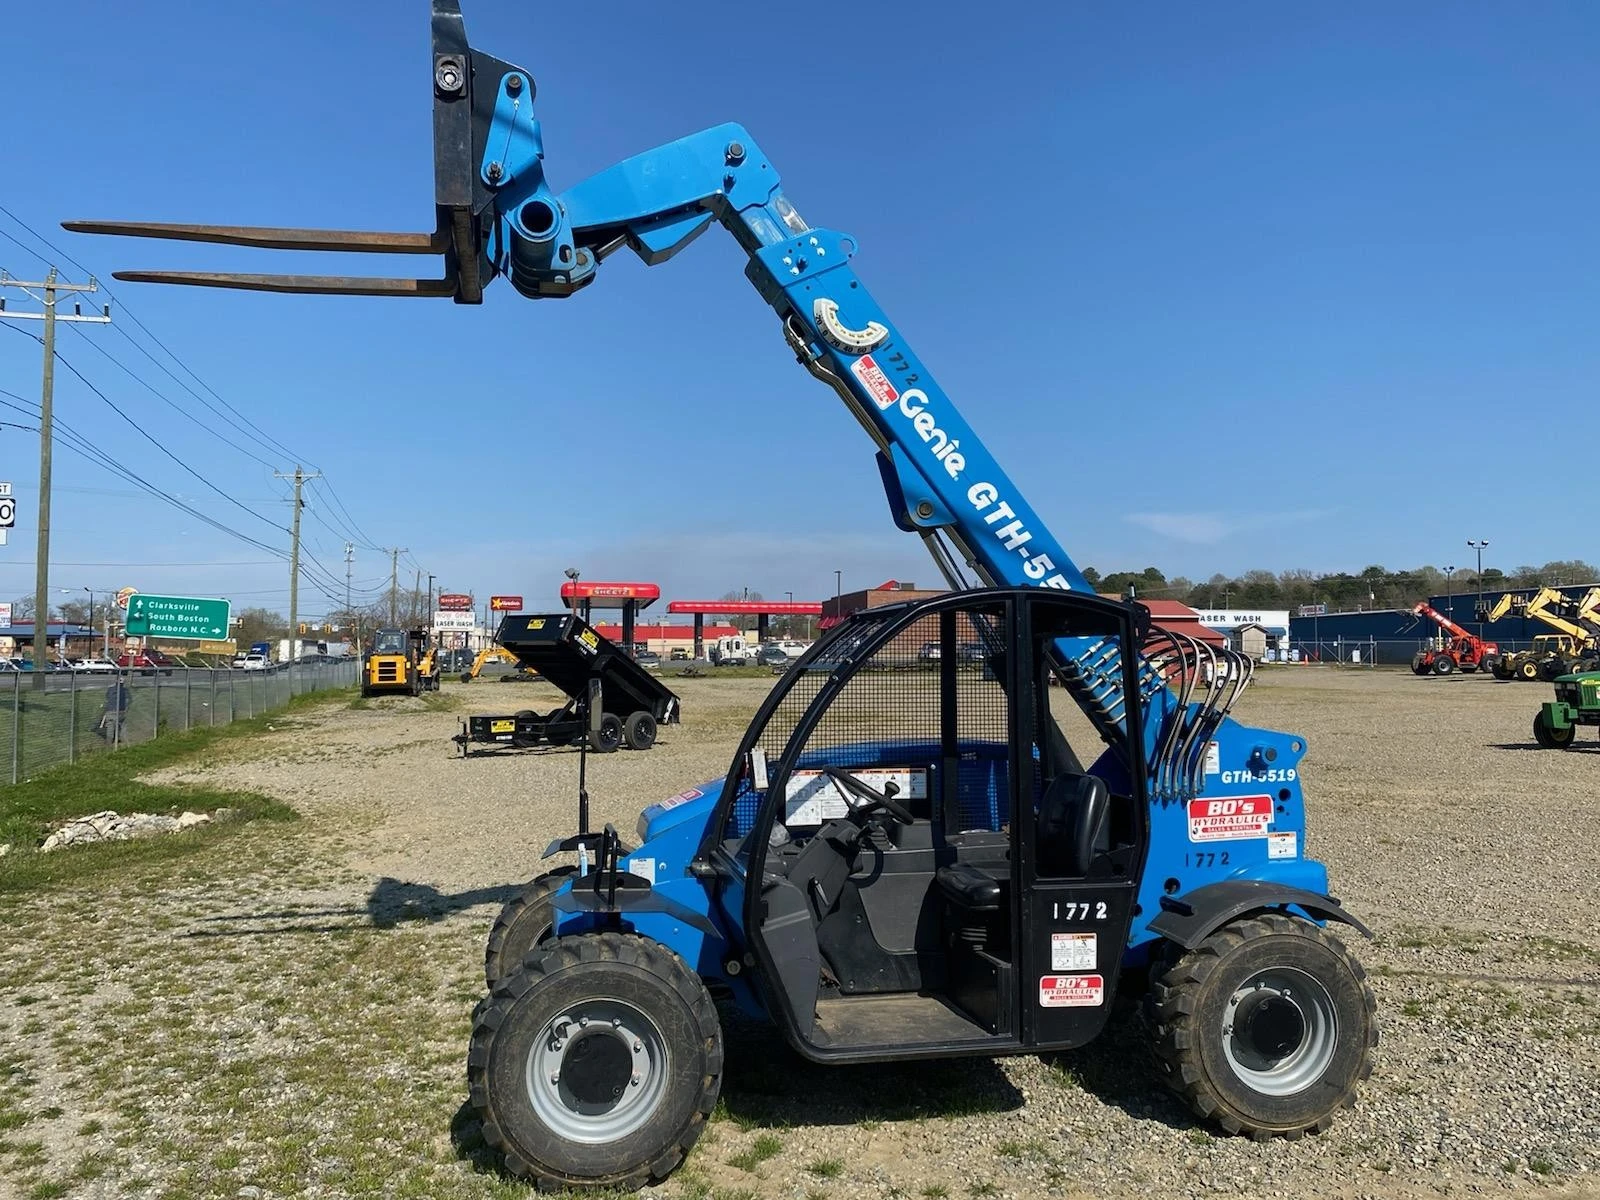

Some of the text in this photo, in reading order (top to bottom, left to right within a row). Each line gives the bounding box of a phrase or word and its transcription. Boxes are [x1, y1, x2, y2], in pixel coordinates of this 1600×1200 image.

[899, 388, 966, 479] Genie
[967, 482, 1072, 590] GTH-55
[148, 601, 200, 611] Clarksville
[147, 612, 209, 623] South Boston
[149, 624, 188, 633] Roxboro
[1221, 769, 1296, 784] GTH-5519
[1207, 800, 1255, 816] BO's
[1194, 815, 1269, 827] HYDRAULICS
[1185, 852, 1229, 869] 1772
[1053, 901, 1107, 920] 1772
[1055, 978, 1089, 989] BO's
